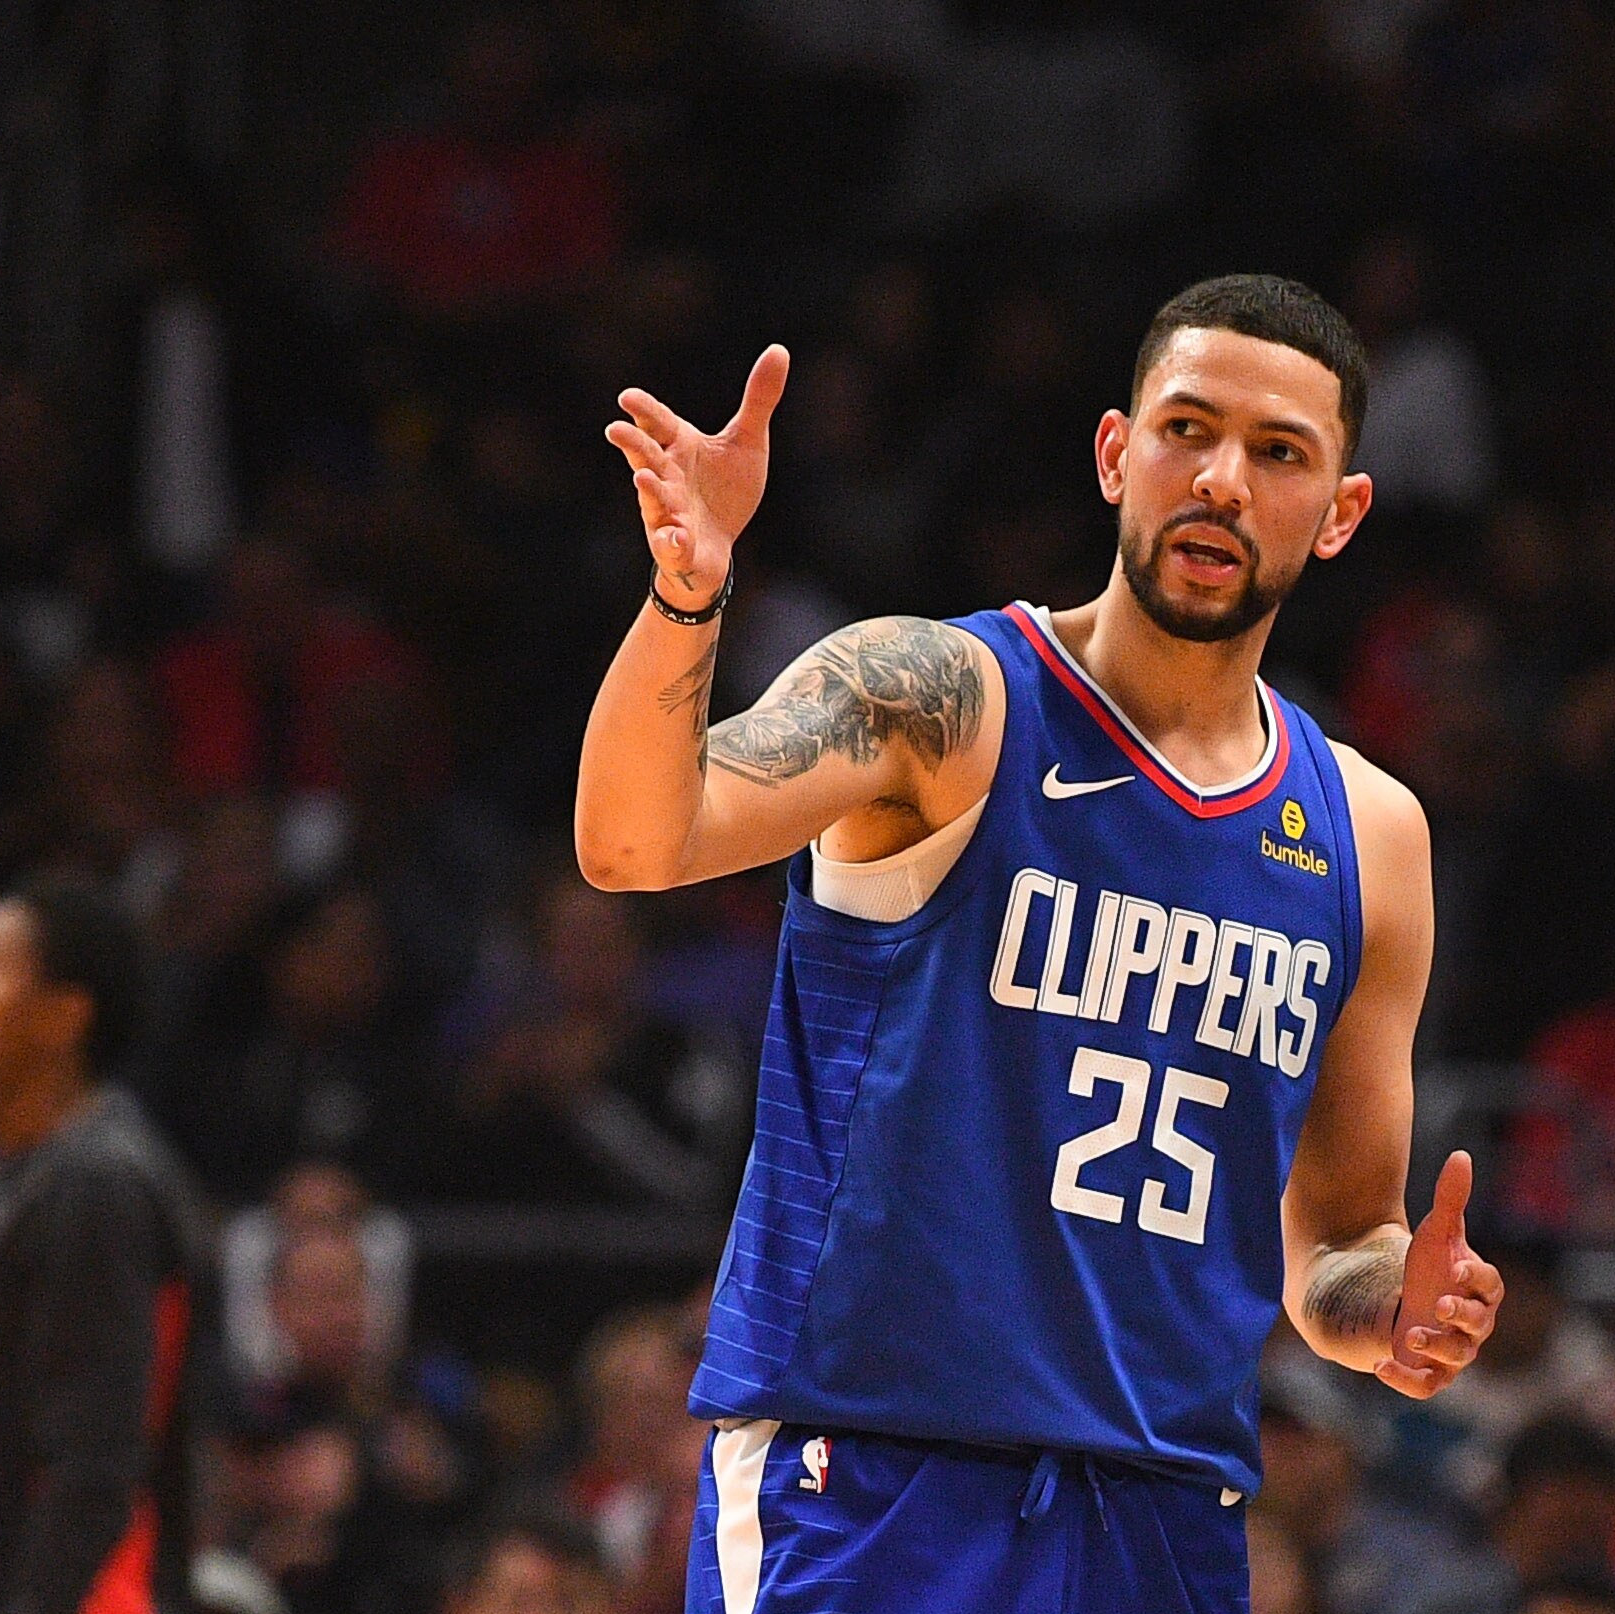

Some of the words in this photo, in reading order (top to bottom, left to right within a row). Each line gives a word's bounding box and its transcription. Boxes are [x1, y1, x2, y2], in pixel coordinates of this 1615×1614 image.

[1261, 830, 1329, 877] bumble
[989, 868, 1331, 1078] CLIPPERS
[1050, 1046, 1230, 1245] 25
